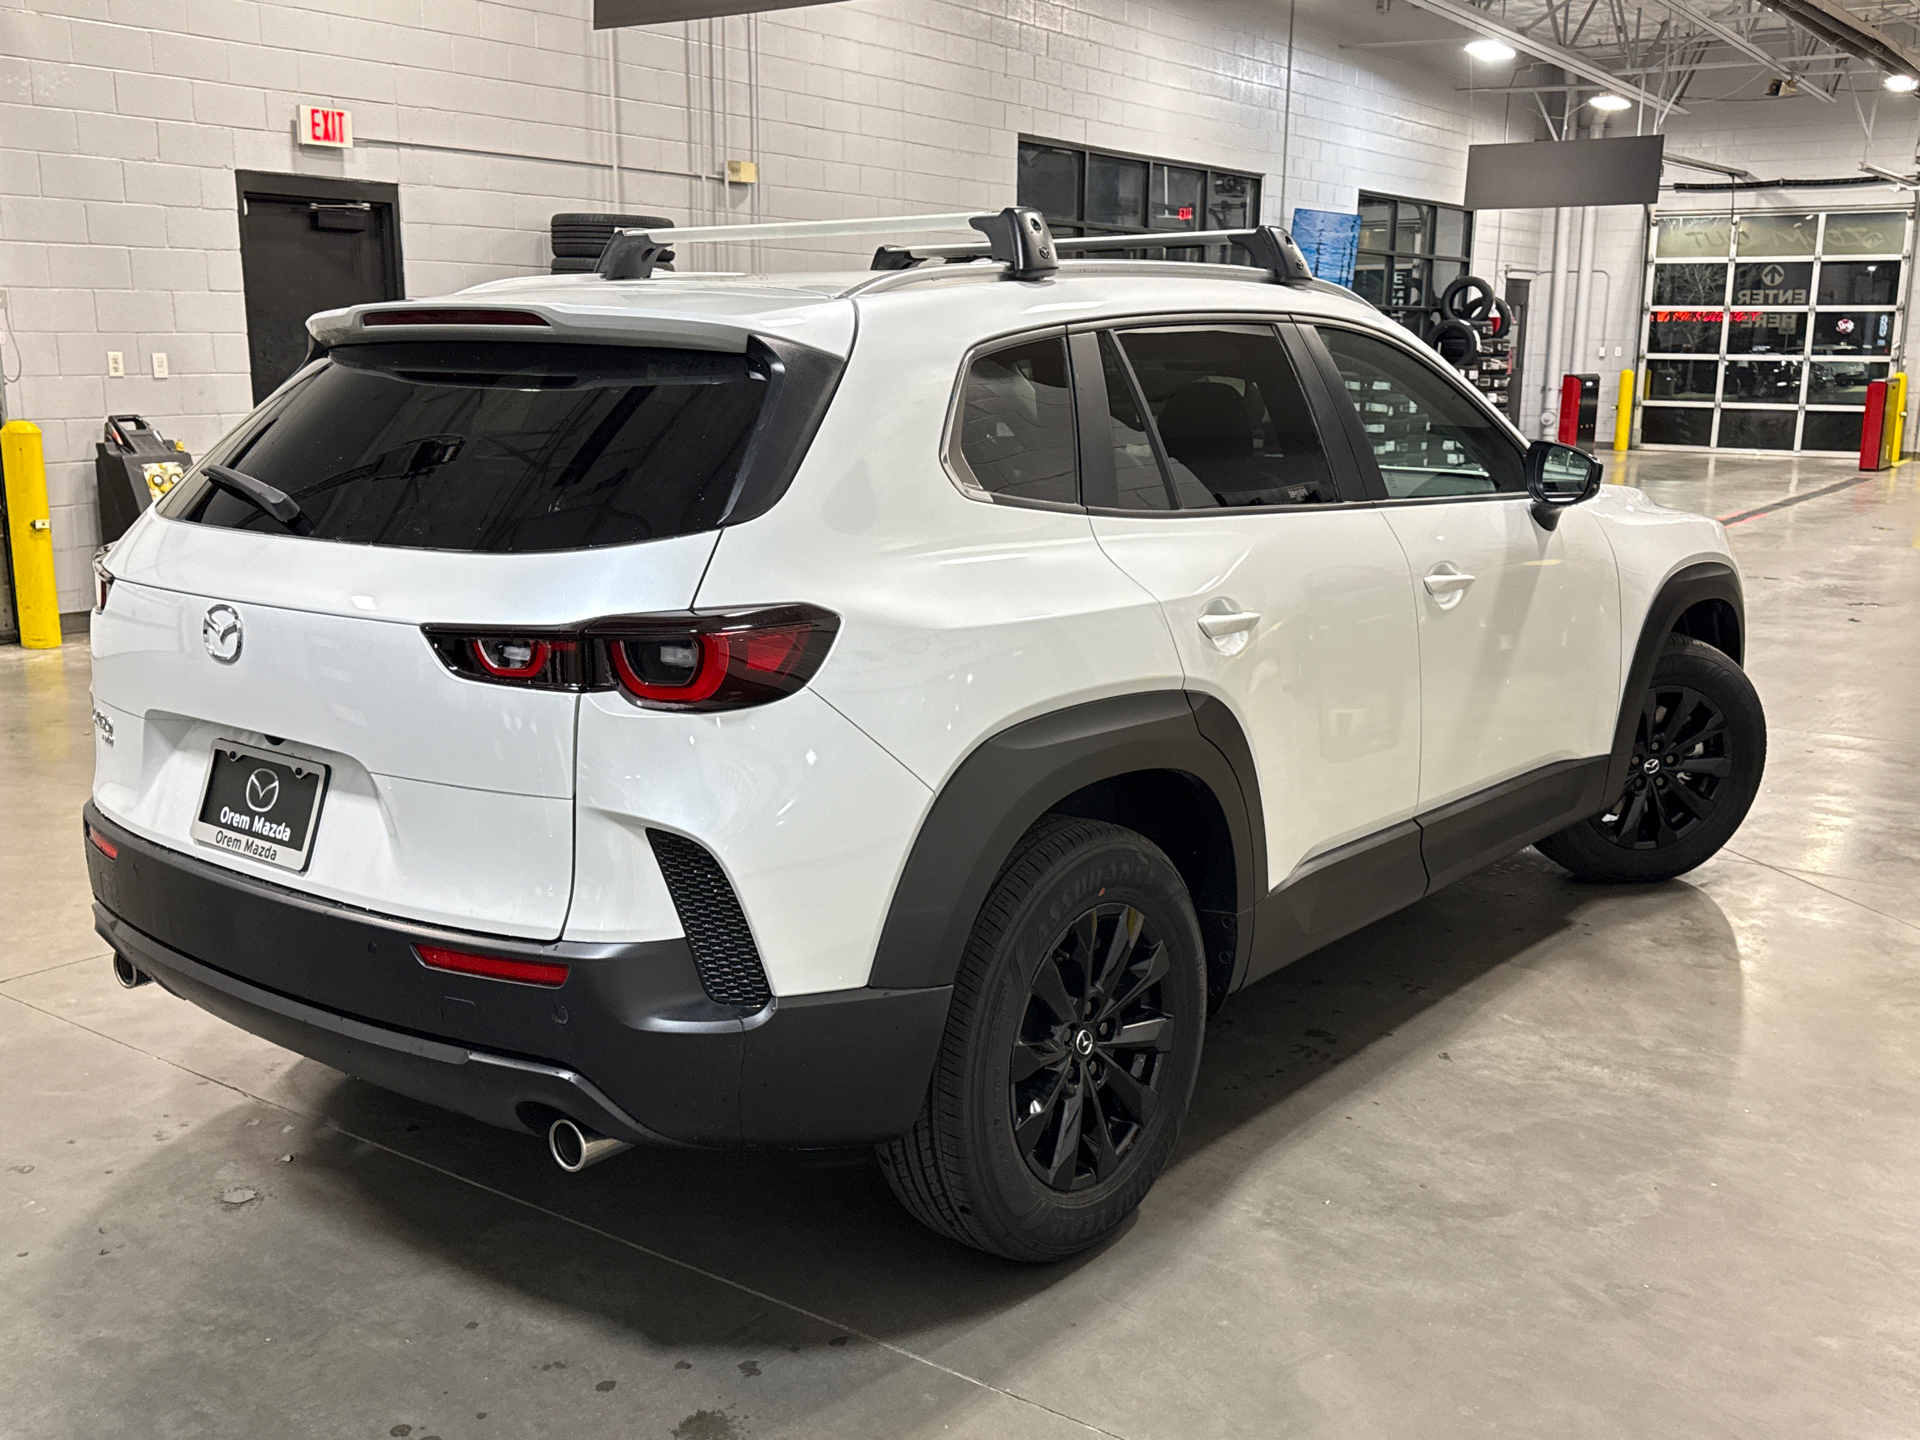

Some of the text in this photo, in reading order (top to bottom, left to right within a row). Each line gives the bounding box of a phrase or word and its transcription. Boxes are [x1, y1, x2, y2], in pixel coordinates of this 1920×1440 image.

[310, 108, 345, 143] EXIT
[220, 806, 291, 842] Orem Mazda
[215, 830, 278, 861] Orem Mazda
